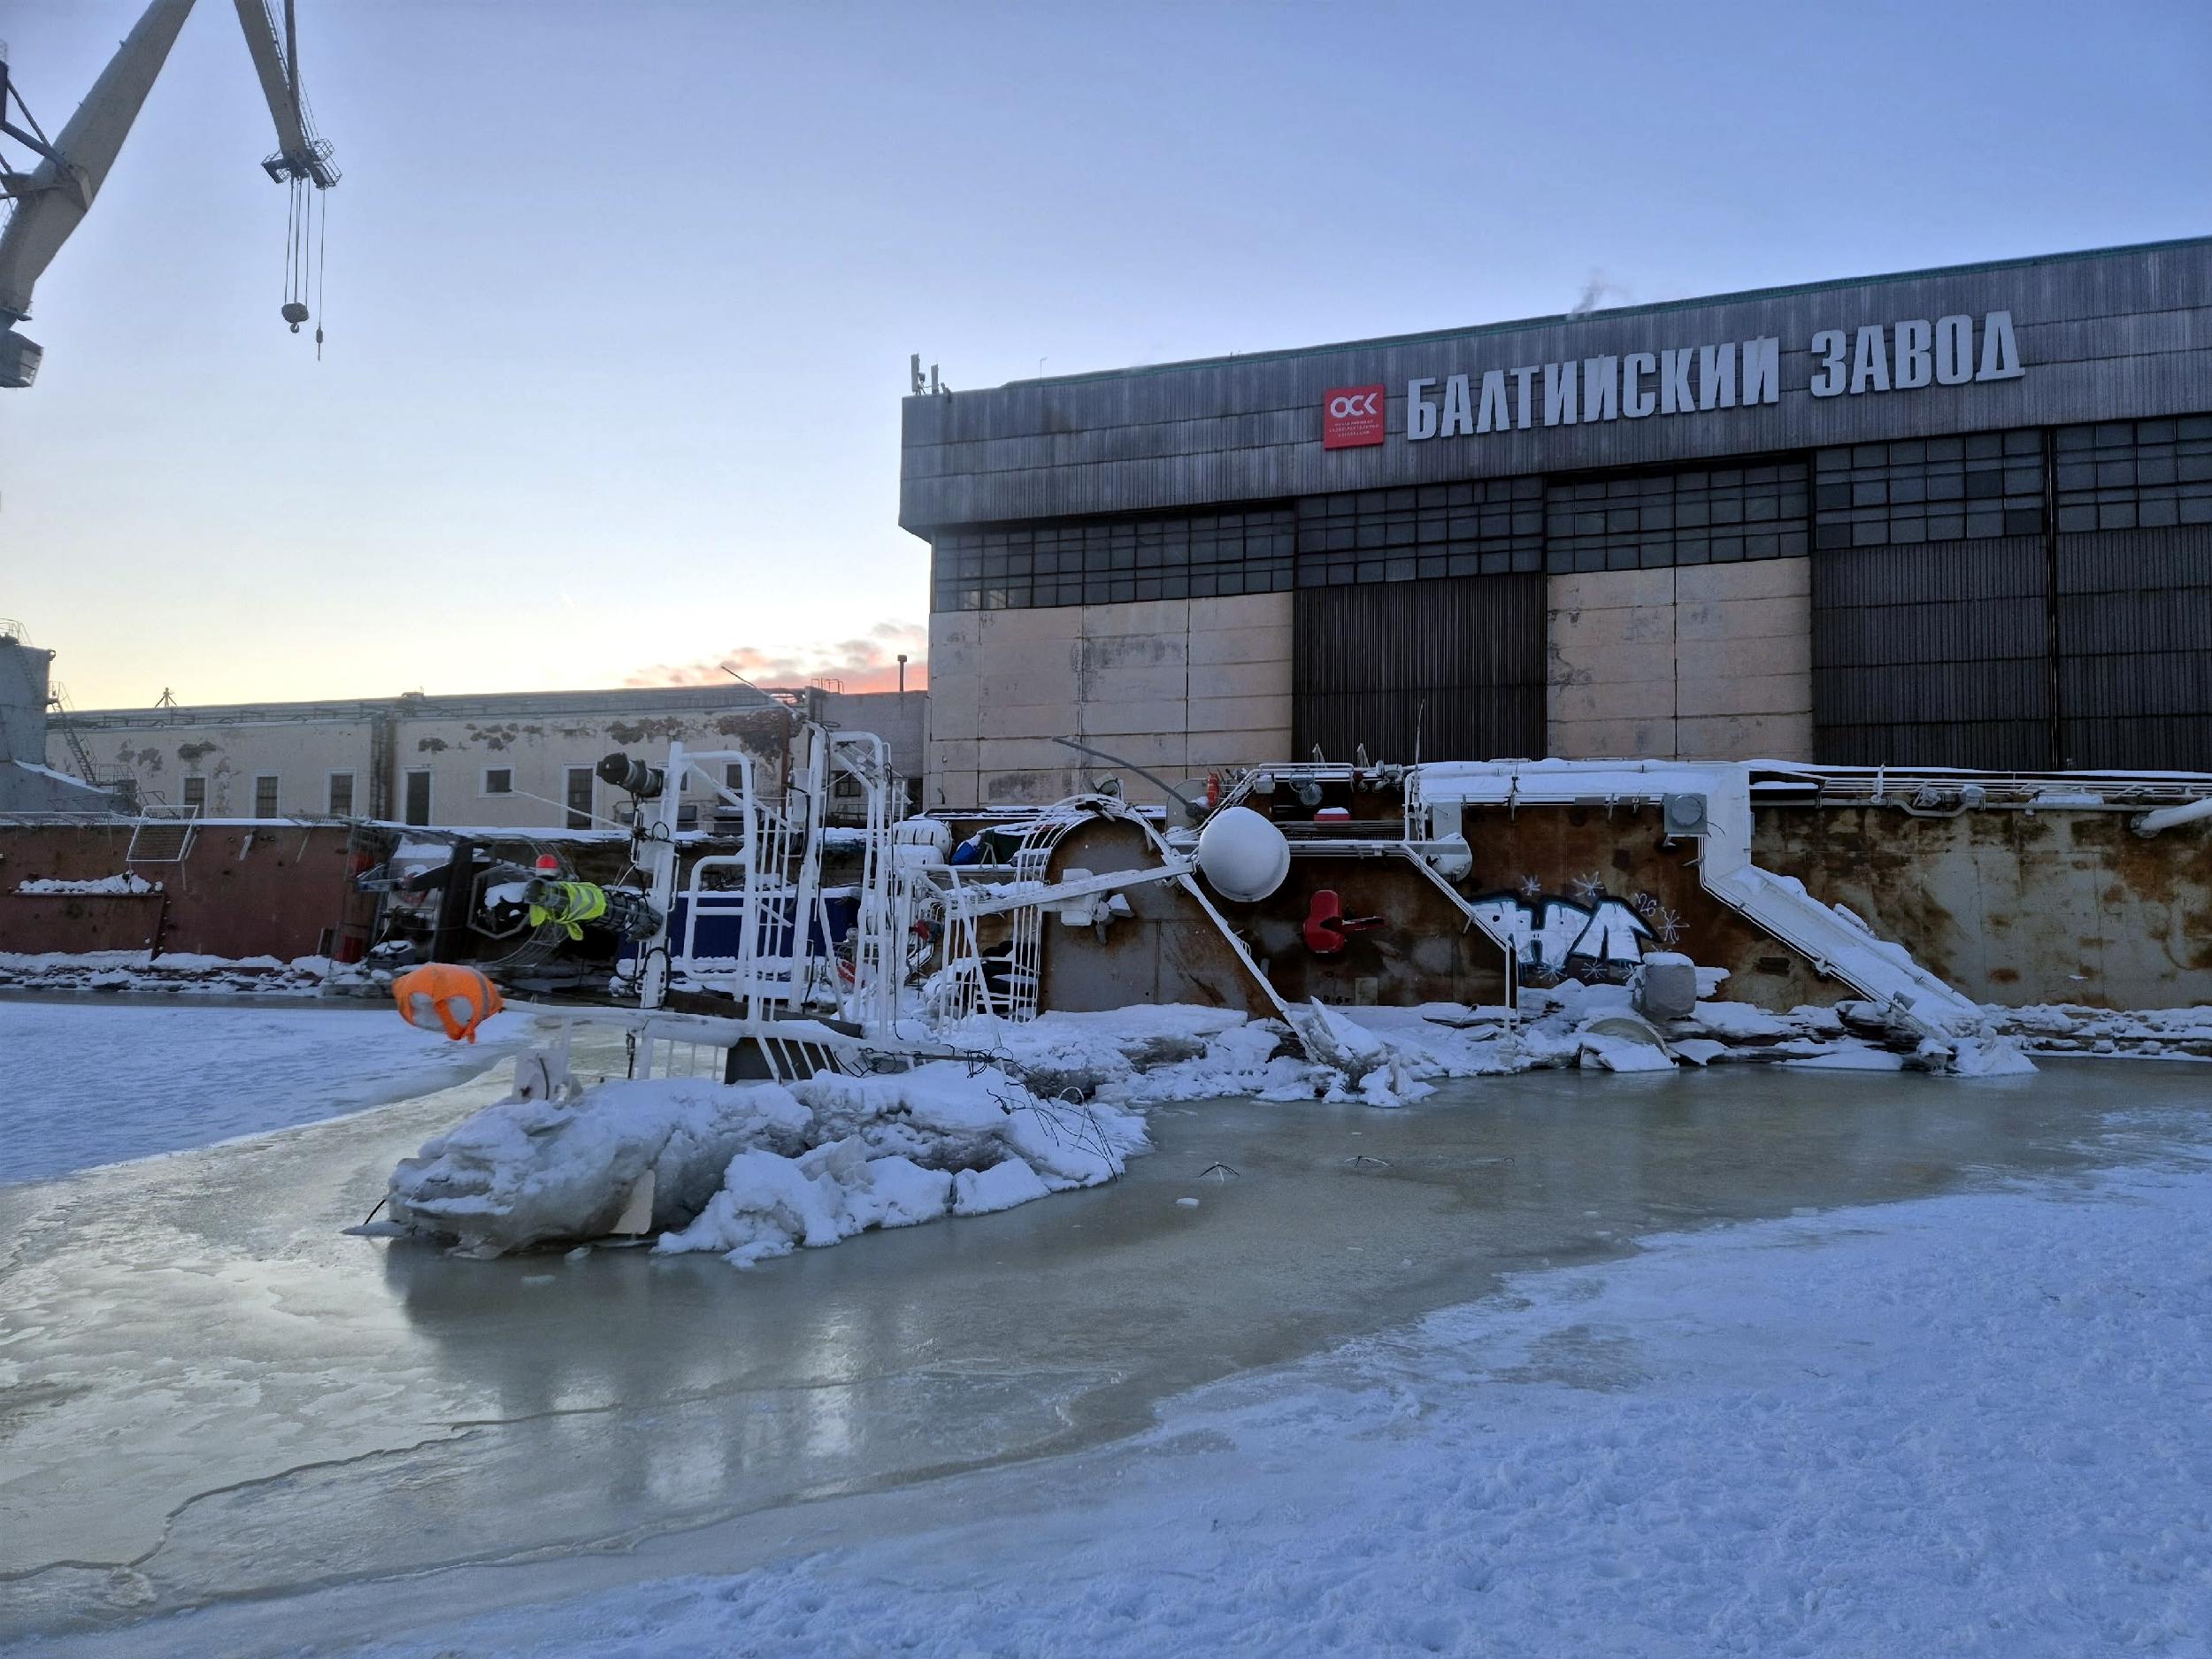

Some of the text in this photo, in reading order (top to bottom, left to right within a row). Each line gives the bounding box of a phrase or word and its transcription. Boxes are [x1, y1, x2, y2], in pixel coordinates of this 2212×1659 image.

[1330, 393, 1379, 418] ОСК
[1407, 311, 2026, 441] БАЛТИЙСКИЙ ЗАВОД
